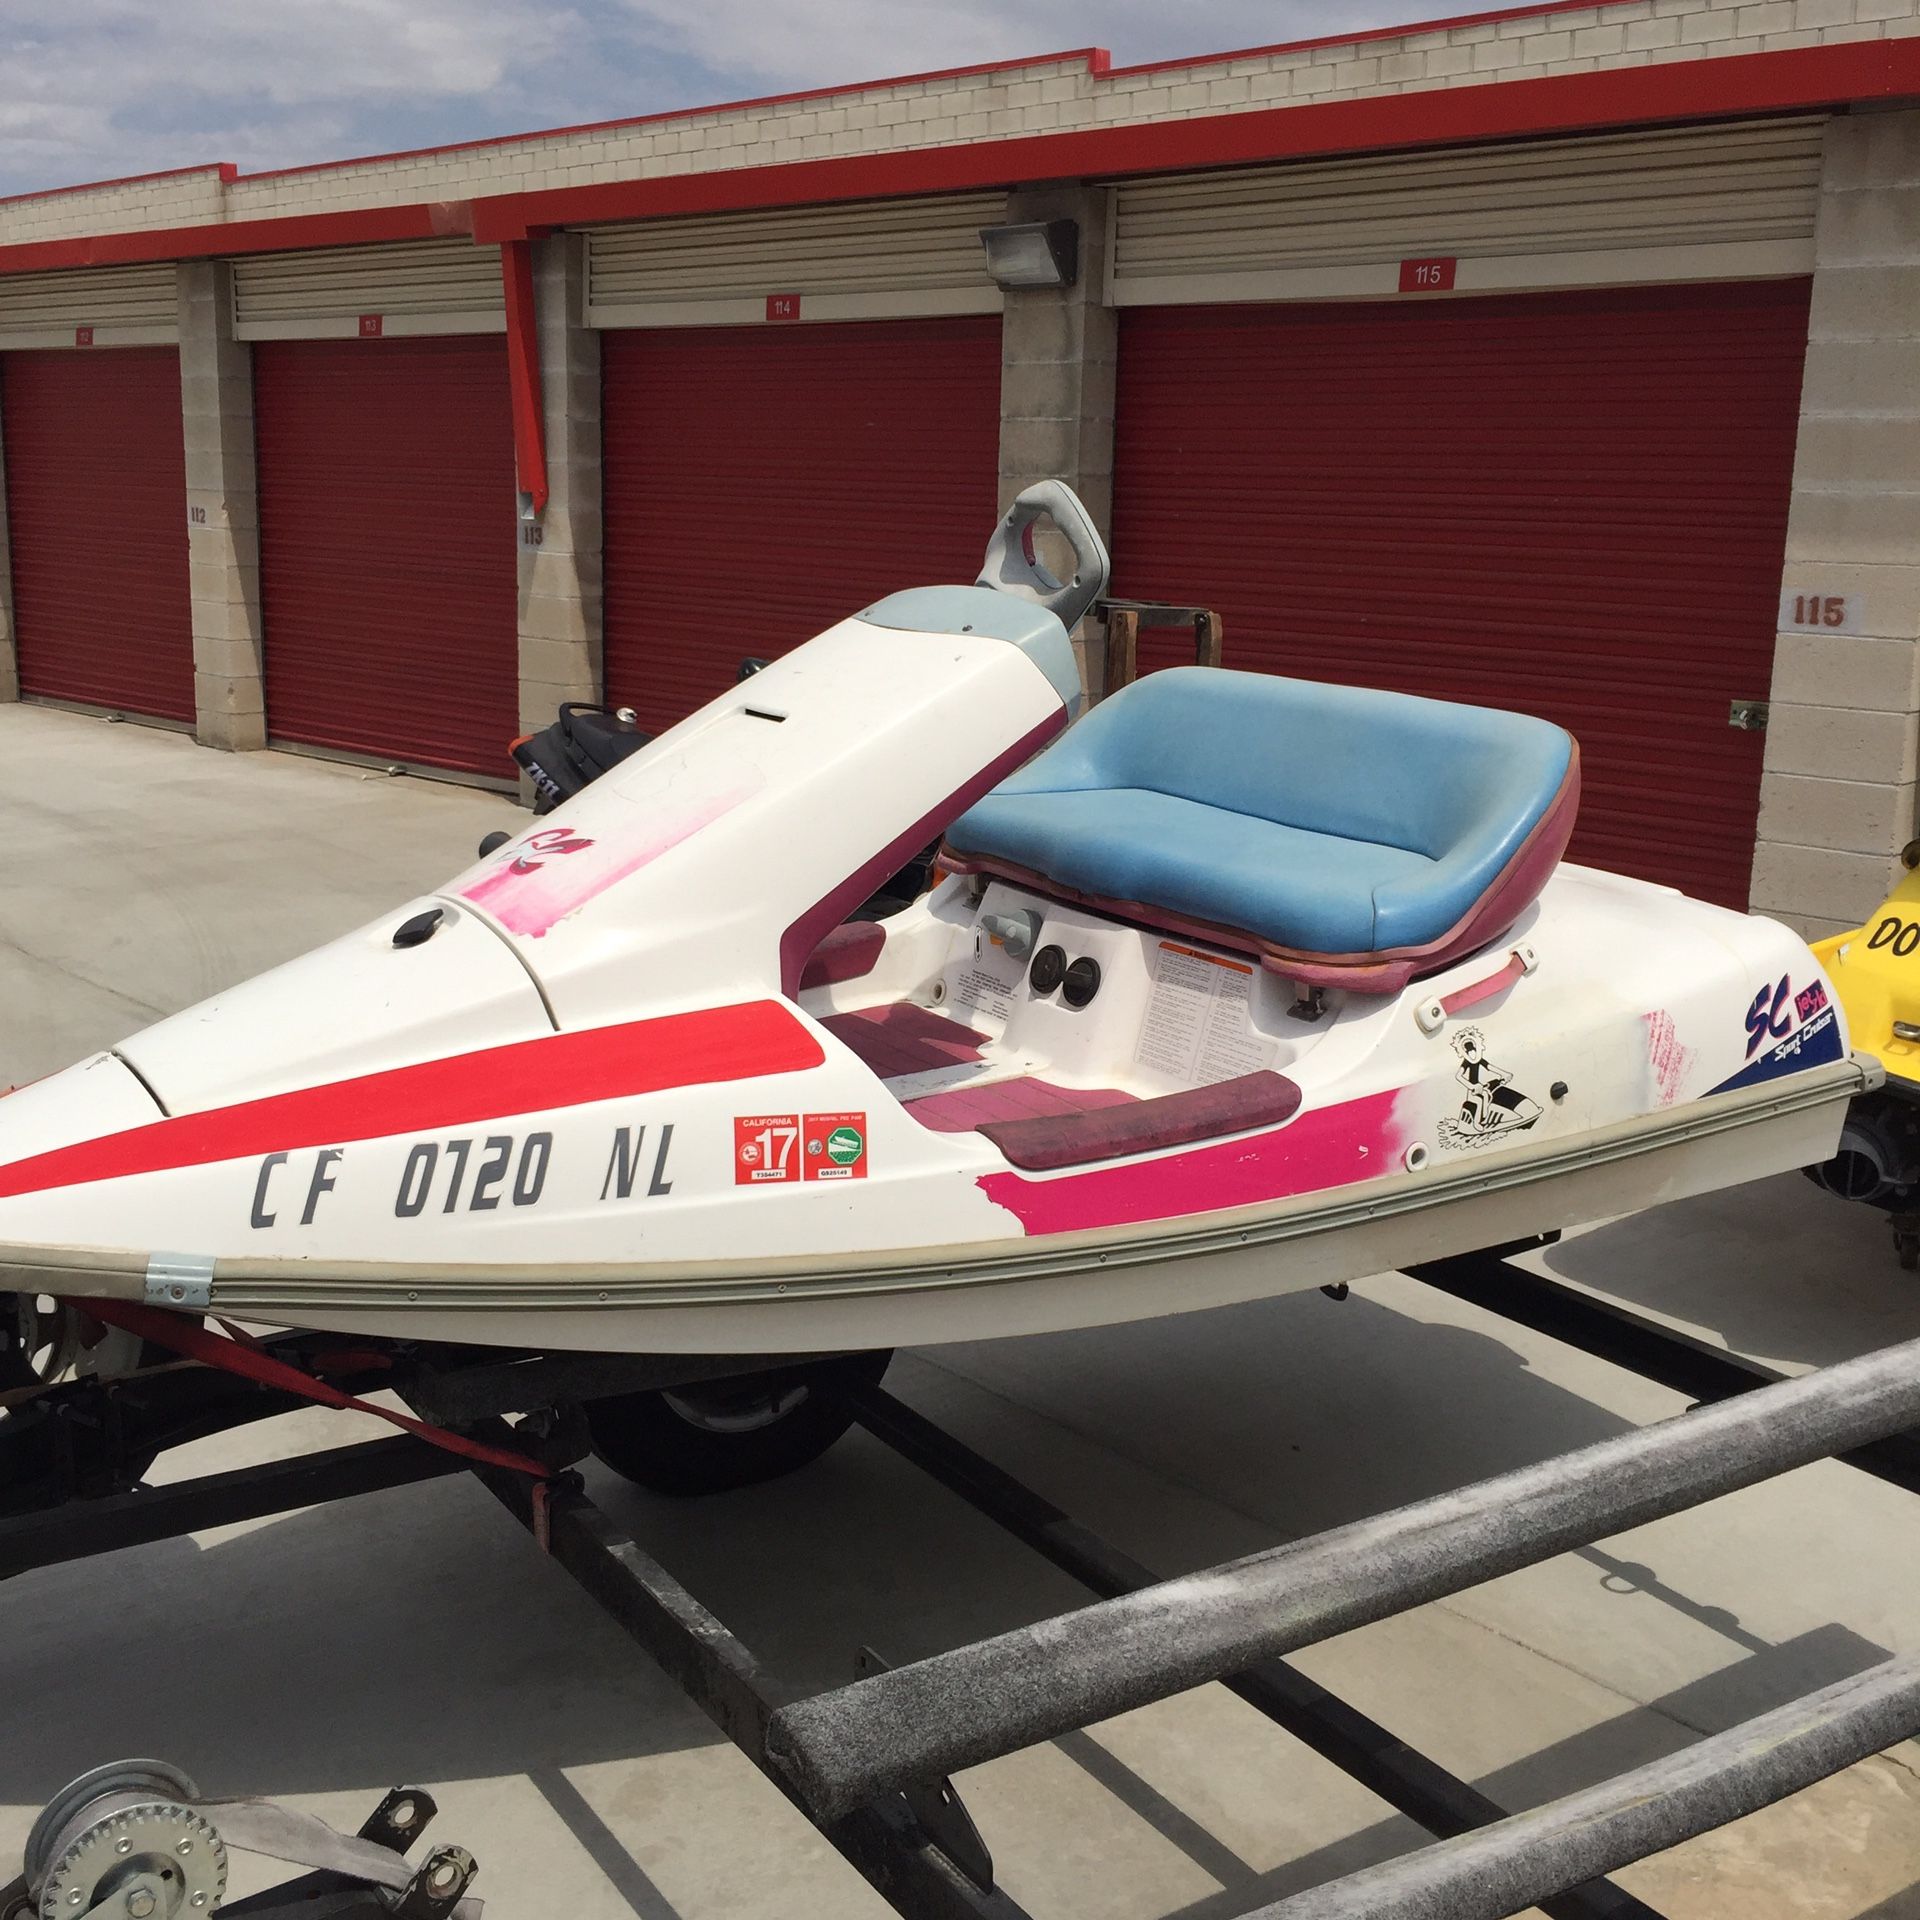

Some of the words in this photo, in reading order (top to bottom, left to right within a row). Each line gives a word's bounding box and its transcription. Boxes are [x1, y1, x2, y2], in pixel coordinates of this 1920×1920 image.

[1415, 265, 1441, 284] 115
[774, 300, 791, 315] 114
[191, 507, 206, 524] 112
[524, 525, 543, 546] 113
[1793, 595, 1845, 627] 115
[1867, 916, 1920, 957] DO
[1744, 972, 1793, 1061] SC
[1774, 1034, 1802, 1061] Sport
[742, 1118, 793, 1128] CALIFORNIA
[755, 1127, 798, 1170] 17
[394, 1131, 553, 1218] 0720
[600, 1124, 675, 1201] NL
